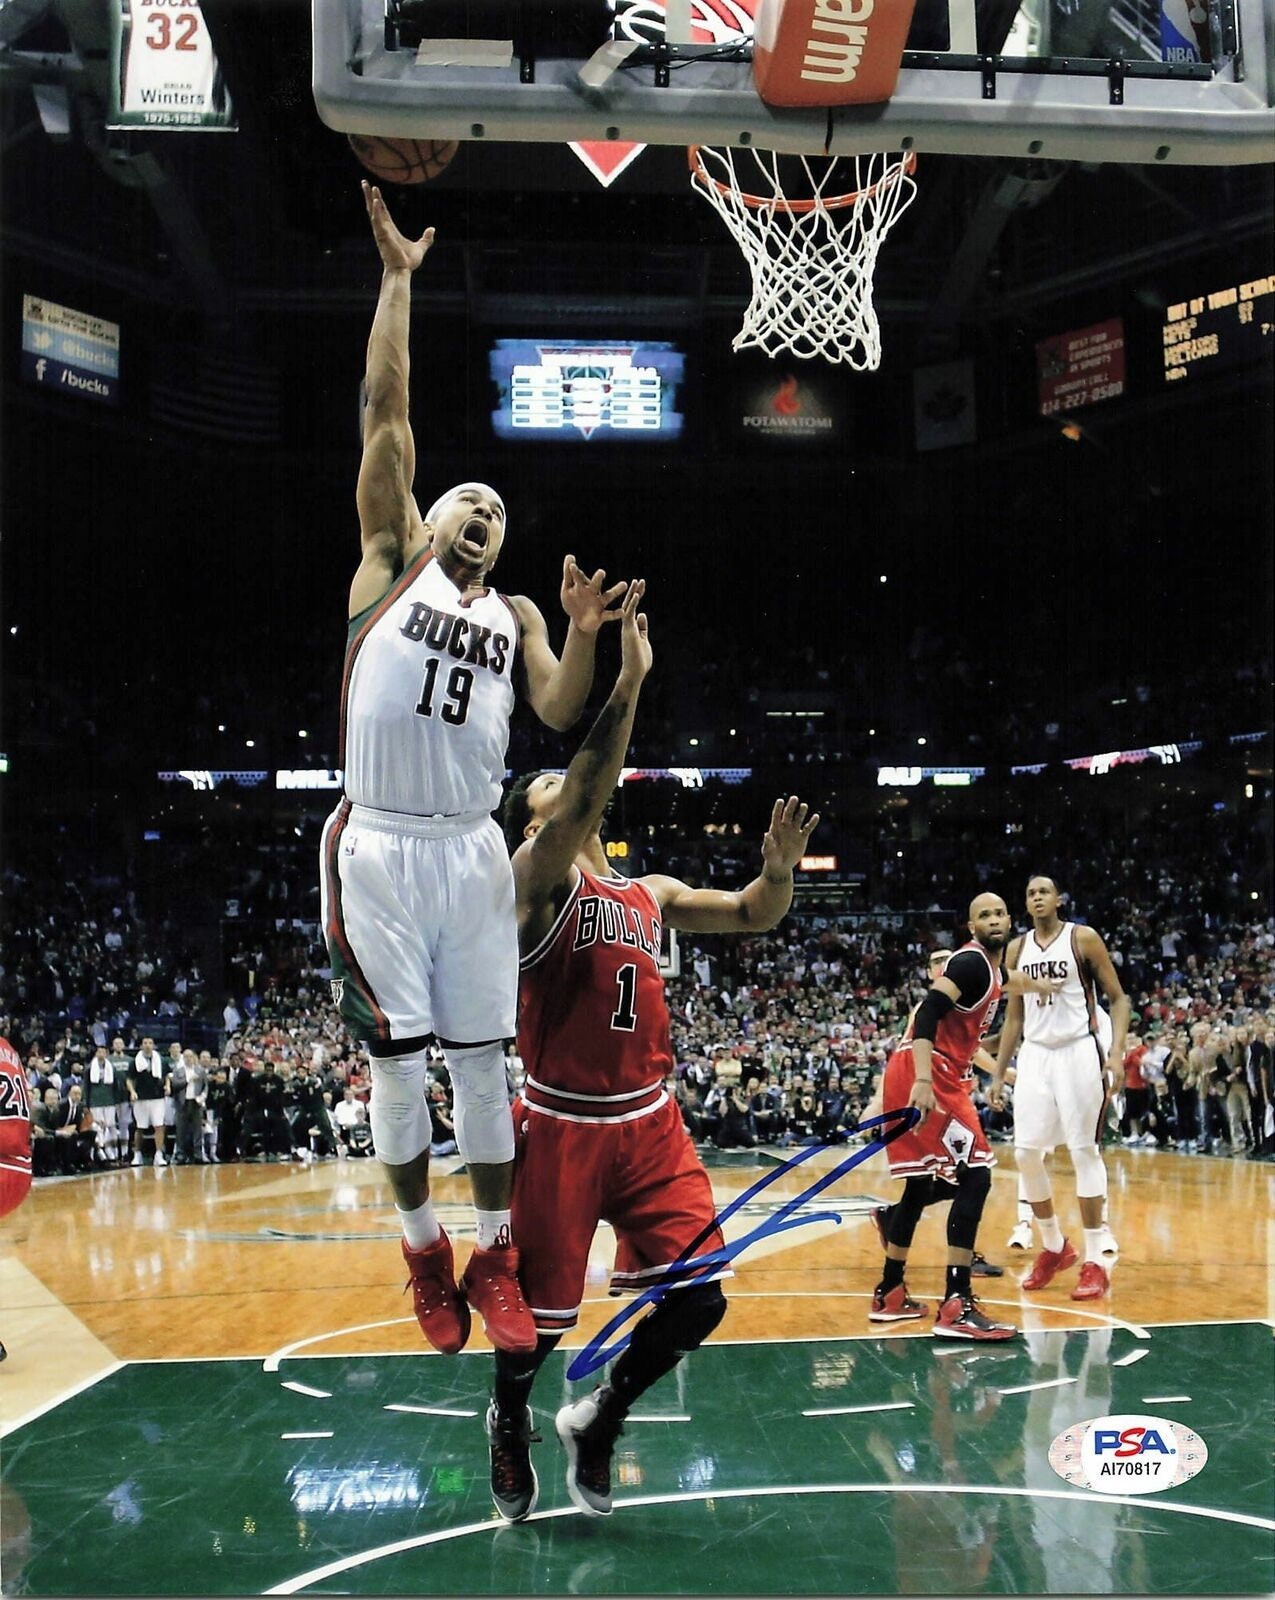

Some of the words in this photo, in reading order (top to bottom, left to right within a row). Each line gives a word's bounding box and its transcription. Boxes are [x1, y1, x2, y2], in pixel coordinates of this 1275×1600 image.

[146, 13, 198, 51] 32
[1166, 47, 1195, 63] NBA
[141, 88, 205, 106] Winters
[61, 368, 110, 396] /bucks
[742, 415, 833, 429] POTAWATOMI
[399, 601, 510, 676] BUCKS
[414, 655, 475, 726] 19
[610, 962, 637, 1032] 1
[0, 1070, 30, 1121] 21
